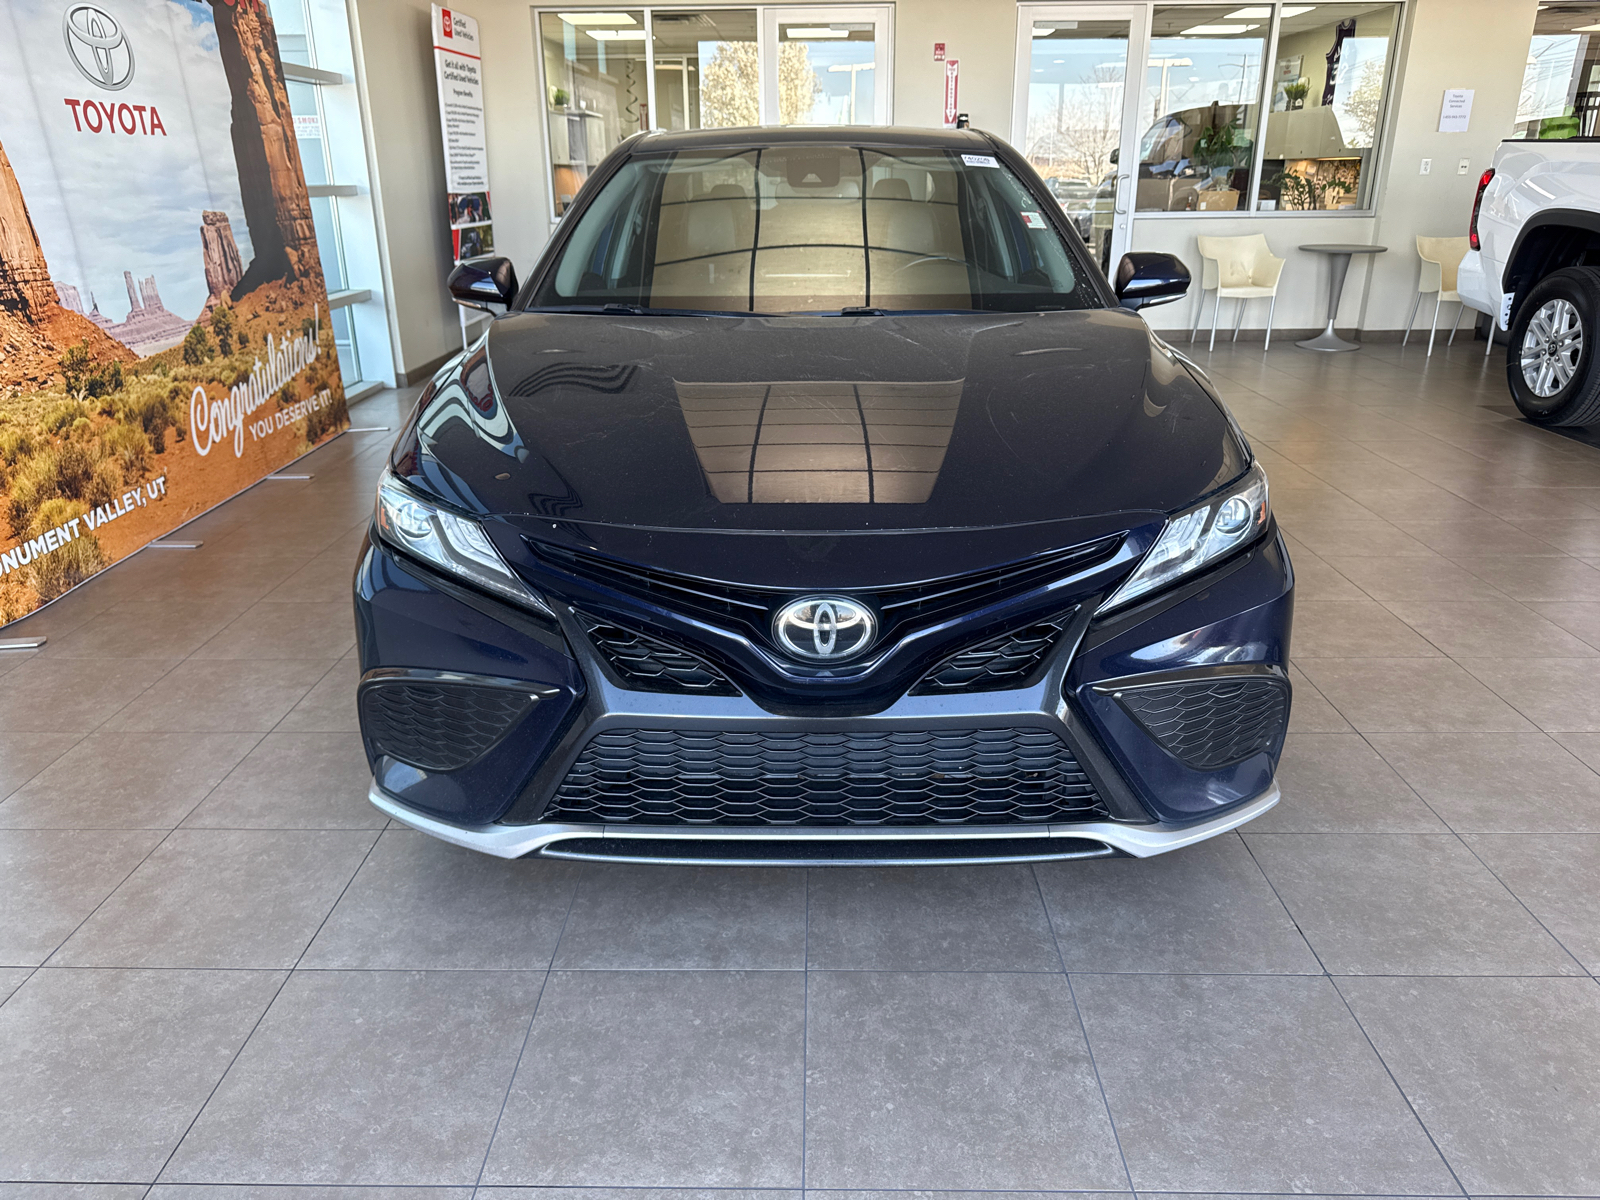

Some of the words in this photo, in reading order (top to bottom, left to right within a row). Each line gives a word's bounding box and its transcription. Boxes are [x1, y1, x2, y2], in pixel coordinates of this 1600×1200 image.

[453, 16, 466, 29] Certified
[463, 30, 474, 41] Vehicles
[444, 70, 458, 81] Certified
[467, 76, 479, 85] Vehicles
[466, 63, 477, 74] Toyota
[64, 98, 167, 136] TOYOTA
[190, 302, 321, 458] Congratulations!
[249, 416, 274, 442] YOU
[274, 394, 321, 430] DESERVE
[318, 388, 333, 407] IT!
[0, 517, 80, 577] NUMENT
[82, 487, 147, 532] VALLEY,
[146, 475, 166, 500] UT
